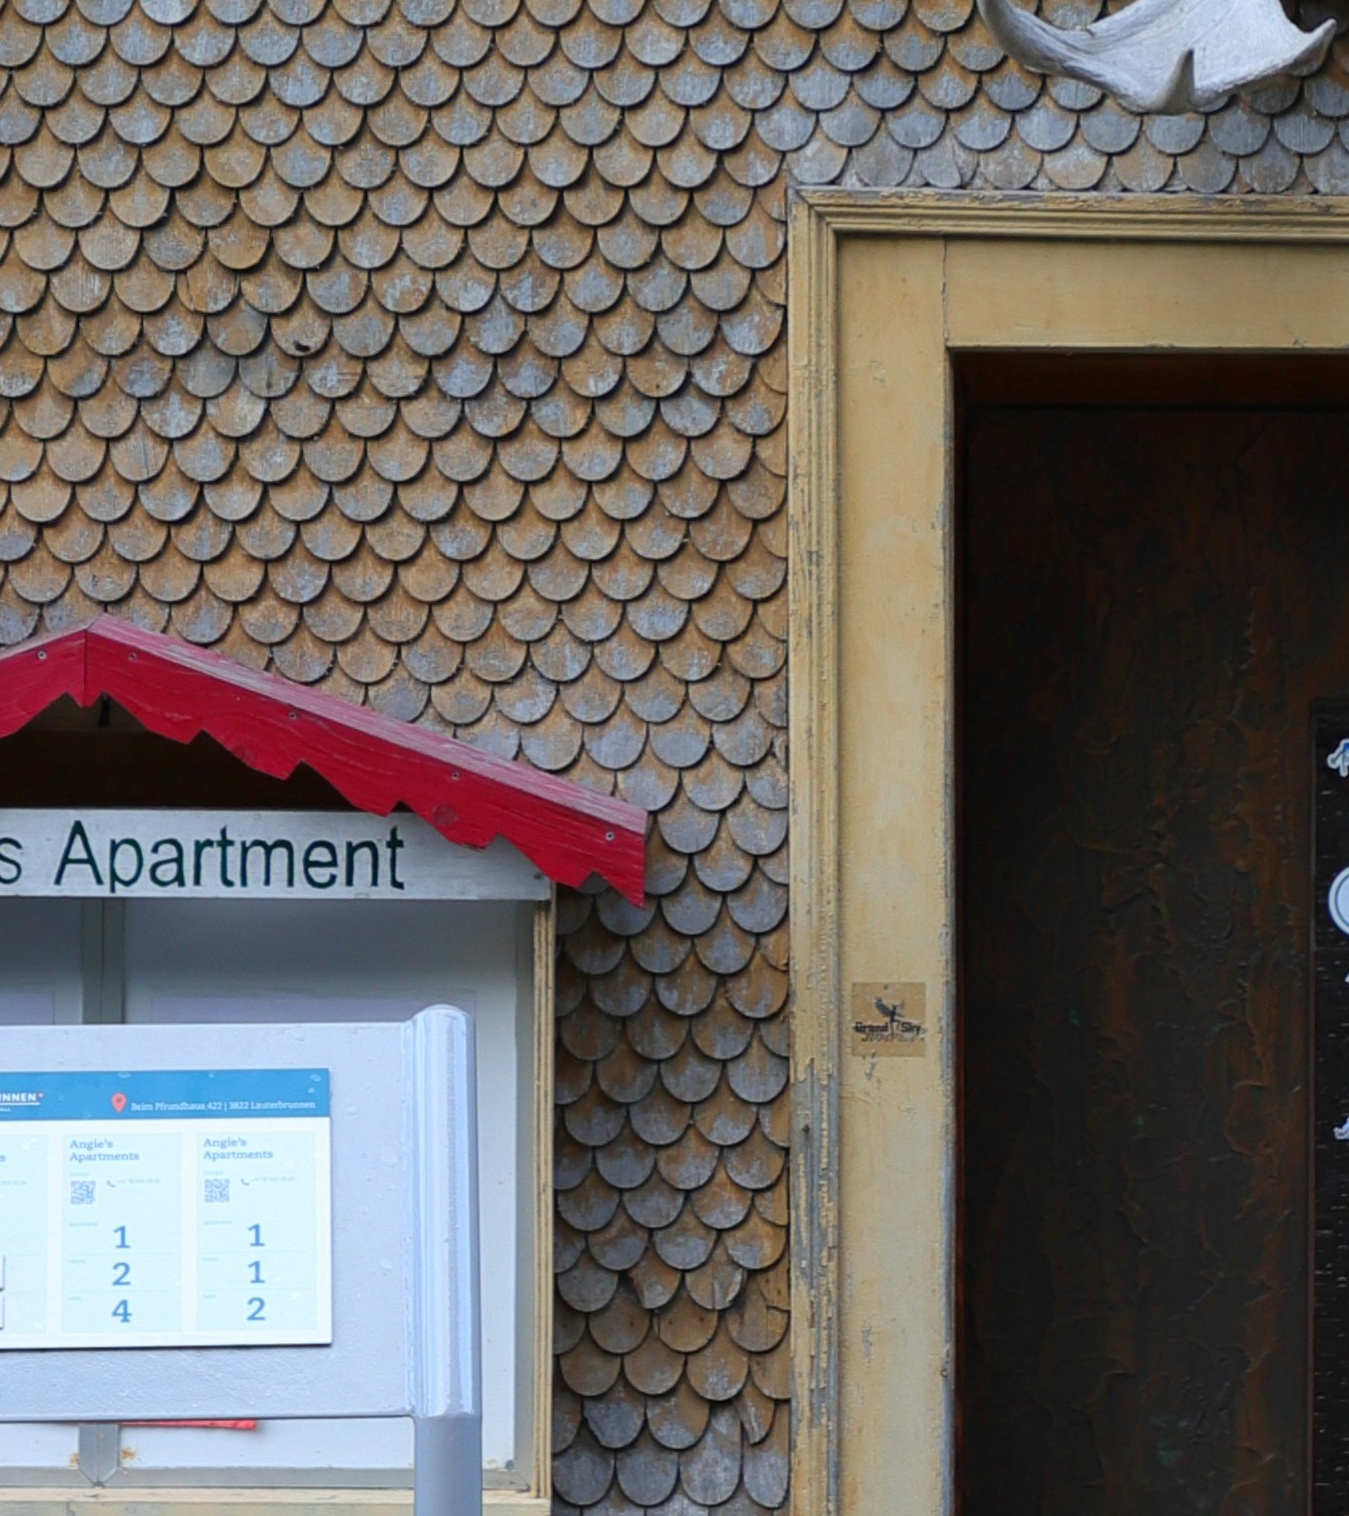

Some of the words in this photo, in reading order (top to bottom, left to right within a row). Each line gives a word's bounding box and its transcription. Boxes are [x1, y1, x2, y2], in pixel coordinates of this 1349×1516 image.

[53, 818, 405, 894] Apartment
[207, 1102, 222, 1111] 422
[251, 1100, 316, 1110] Lauterbrunnen
[70, 1138, 113, 1151] Angie's
[203, 1137, 247, 1150] Angie's
[69, 1150, 140, 1164] Apartments
[203, 1150, 273, 1161] Apartments
[113, 1225, 131, 1248] 1
[248, 1223, 265, 1247] 1
[112, 1262, 131, 1285] 2
[248, 1260, 265, 1284] 1
[111, 1299, 132, 1323] 4
[247, 1297, 266, 1321] 2
